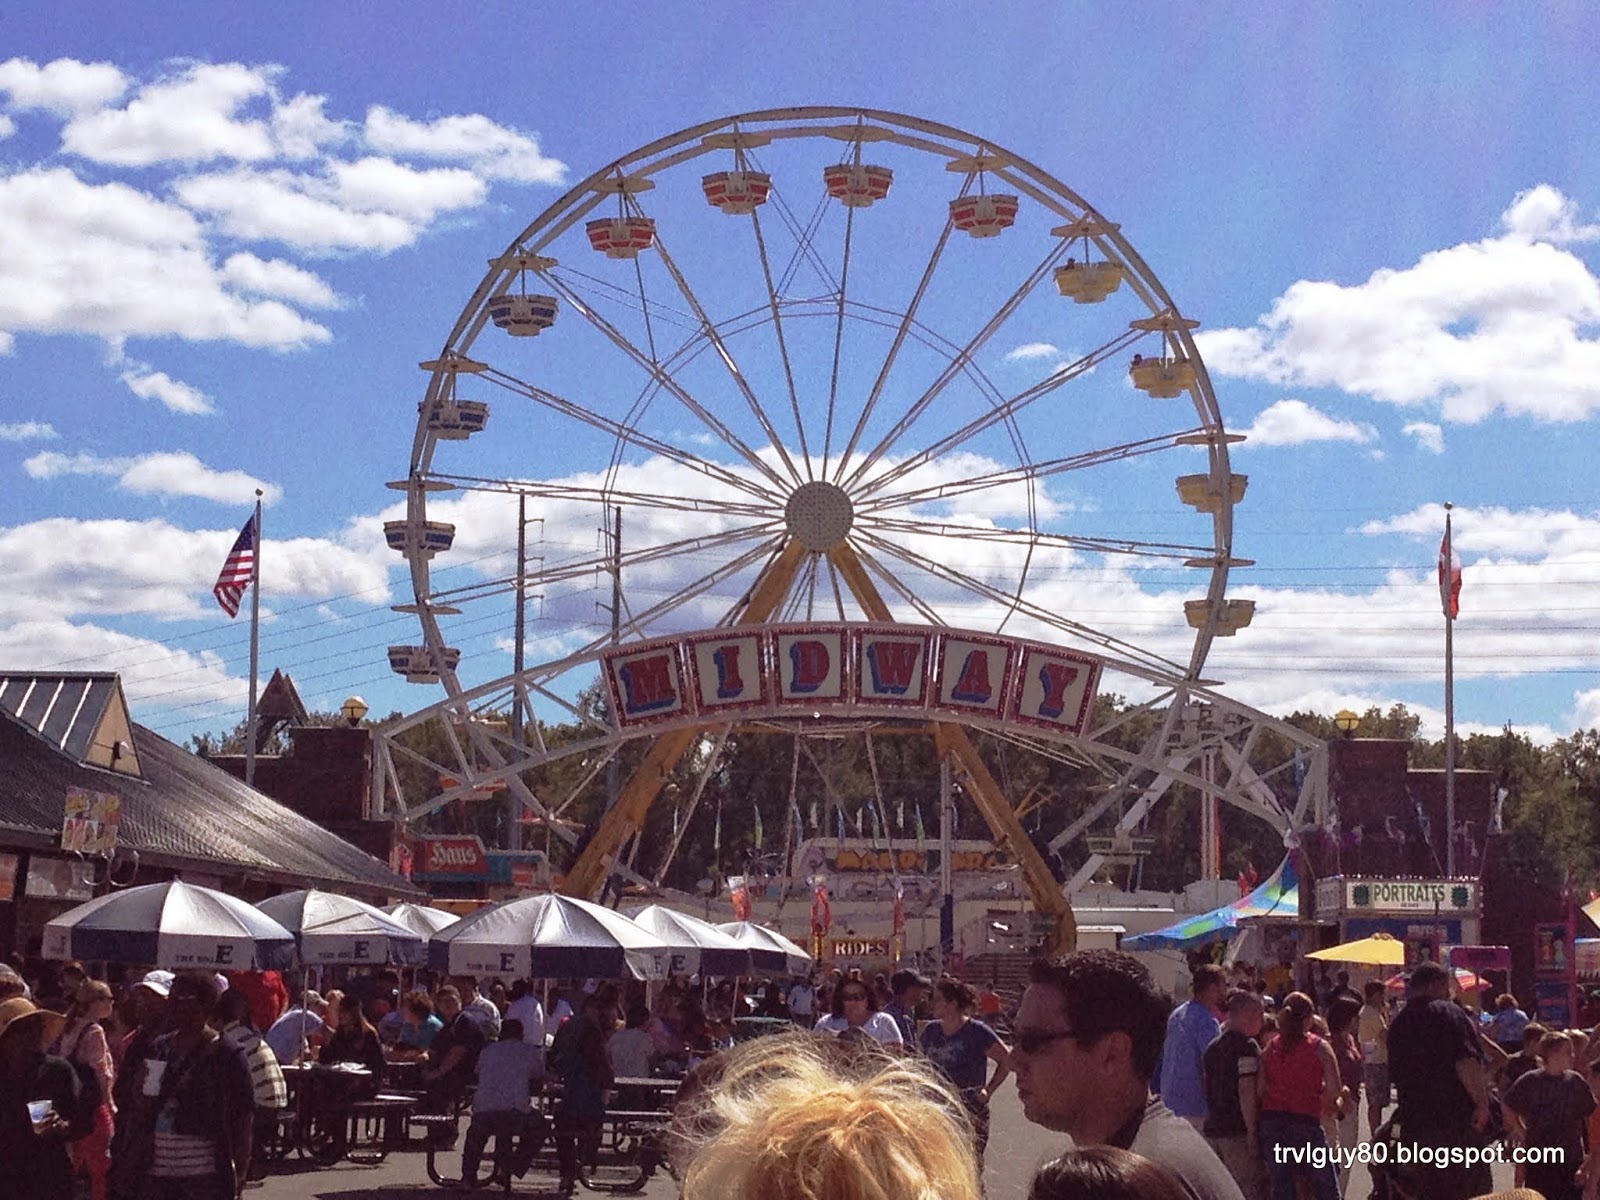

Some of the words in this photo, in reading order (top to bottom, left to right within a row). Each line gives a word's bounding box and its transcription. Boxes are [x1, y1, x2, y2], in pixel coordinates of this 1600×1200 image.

[619, 640, 1078, 718] MIDWAY
[1374, 884, 1446, 902] PORTRAITS
[215, 944, 234, 965] E
[354, 941, 370, 959] E
[835, 942, 884, 956] RIDES
[500, 952, 515, 972] E
